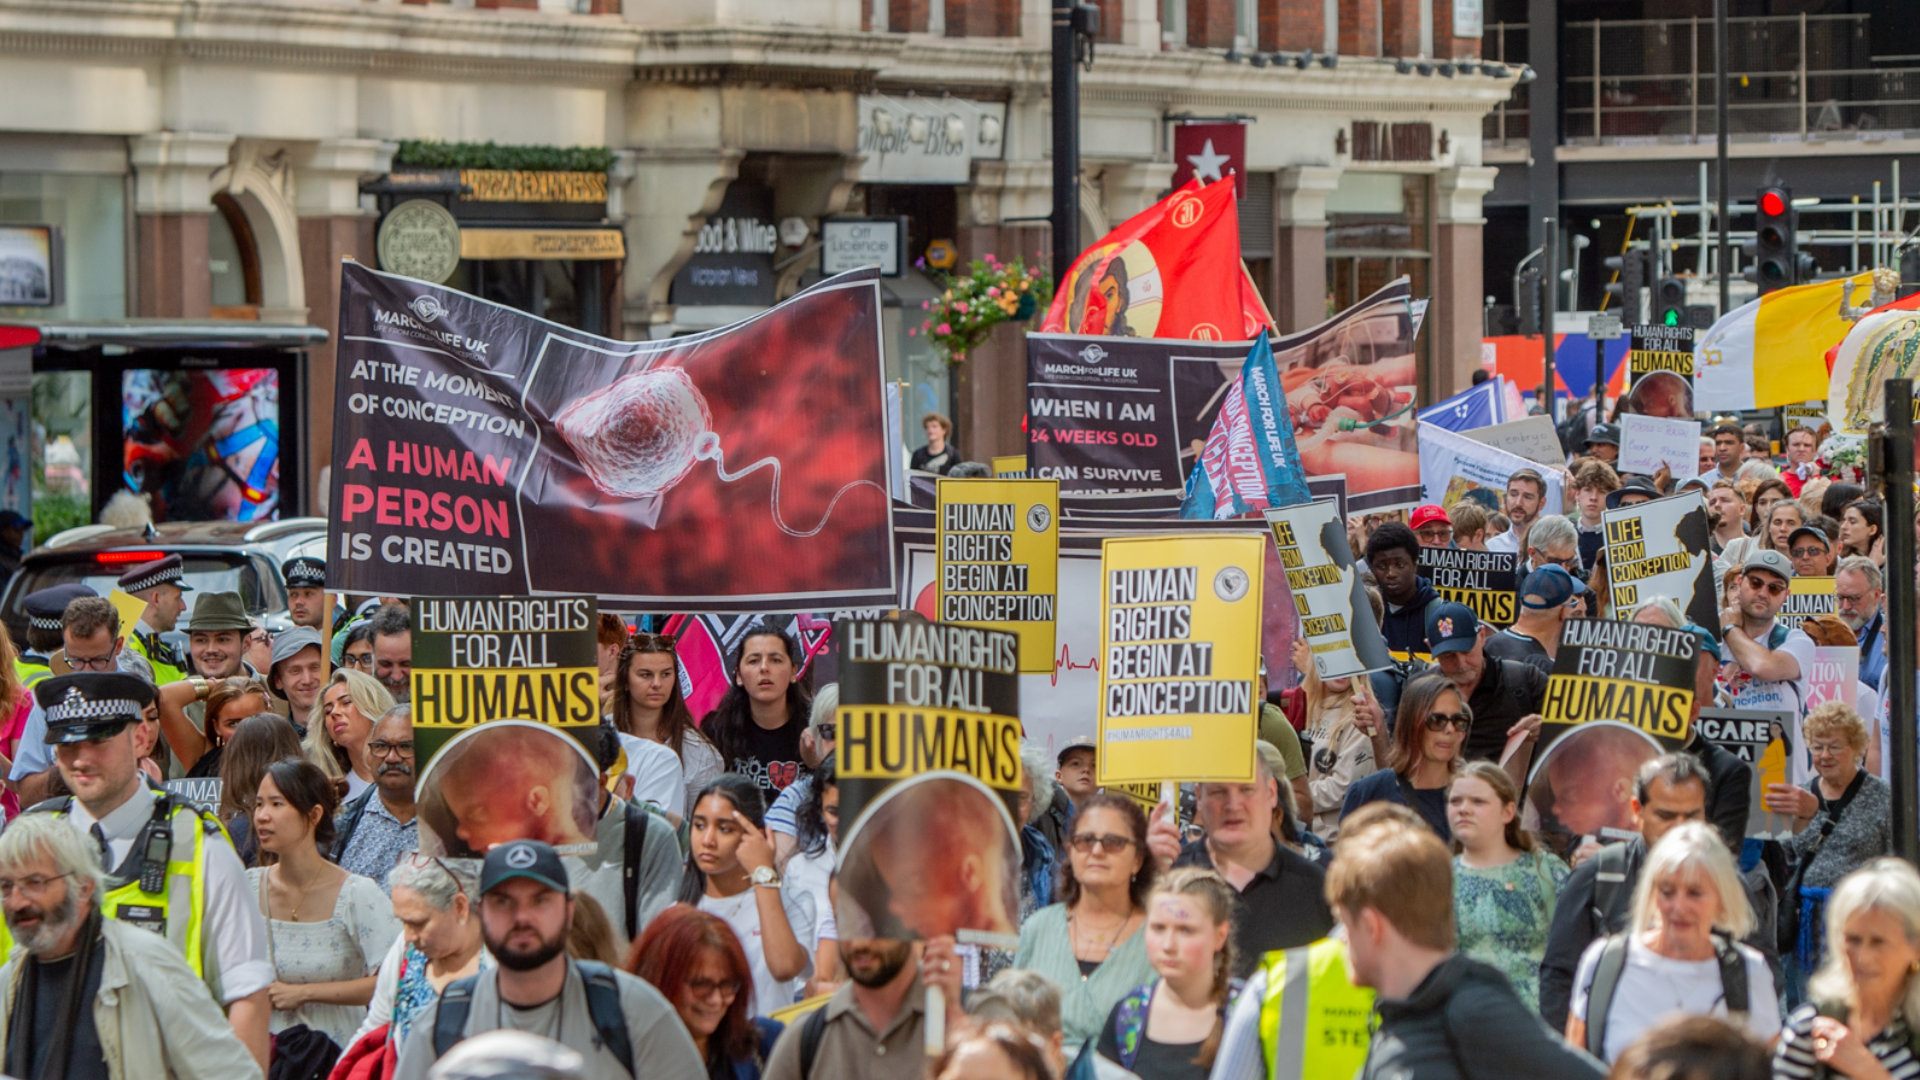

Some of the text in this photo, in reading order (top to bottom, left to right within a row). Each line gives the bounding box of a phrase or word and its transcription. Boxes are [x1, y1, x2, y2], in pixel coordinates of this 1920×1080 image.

[695, 217, 777, 253] ood & Wine
[832, 238, 889, 252] Licence
[465, 337, 490, 354] UK
[1632, 324, 1693, 340] HUMAN RIGHTS
[1643, 338, 1680, 352] FOR ALL
[1122, 367, 1138, 378] UK
[1631, 351, 1694, 374] HUMANS
[350, 359, 515, 409] AT THE MOMENT
[348, 393, 526, 440] OF CONCEPTION
[1030, 398, 1156, 422] WHEN I AM
[1251, 366, 1287, 468] MARCH FOR LIFE UK
[1031, 428, 1158, 447] 24 WEEKS OLD
[345, 438, 512, 487] A HUMAN
[1229, 414, 1268, 501] CONCEPTION
[1038, 466, 1079, 480] CAN
[1082, 467, 1163, 481] SURVIVE
[341, 484, 511, 539] PERSON
[944, 504, 1015, 531] HUMAN
[1272, 521, 1296, 546] LIFE
[1607, 517, 1642, 544] LIFE
[341, 532, 513, 575] IS CREATED
[944, 534, 1012, 561] RIGHTS
[1280, 548, 1304, 568] FROM
[1419, 548, 1512, 572] HUMAN RIGHTS
[1610, 541, 1645, 563] FROM
[944, 564, 1027, 591] BEGIN AT
[1286, 564, 1342, 590] CONCEPTION
[1432, 569, 1492, 590] FOR ALL
[1612, 553, 1690, 582] CONCEPTION
[1110, 567, 1197, 604] HUMAN
[1615, 586, 1637, 606] NO
[419, 599, 589, 631] HUMAN RIGHTS
[944, 595, 1054, 622] CONCEPTION
[1440, 592, 1512, 623] MANS
[1781, 595, 1834, 614] HUMAN
[1110, 605, 1191, 642] RIGHTS
[1303, 614, 1347, 637] EXCEPTION
[452, 634, 557, 668] FOR ALL
[849, 622, 1016, 674] HUMAN RIGHTS
[1563, 619, 1696, 659] HUMAN RIGHTS
[1109, 642, 1213, 680] BEGIN AT
[1578, 647, 1660, 684] FOR ALL
[1811, 662, 1846, 683] TION
[415, 672, 595, 724] HUMANS
[887, 663, 992, 714] FOR ALL
[1108, 681, 1251, 717] CONCEPTION
[1545, 678, 1688, 735] HUMANS
[843, 711, 1019, 783] HUMANS
[1106, 727, 1191, 741] #HUMANRIGHTS4ALL
